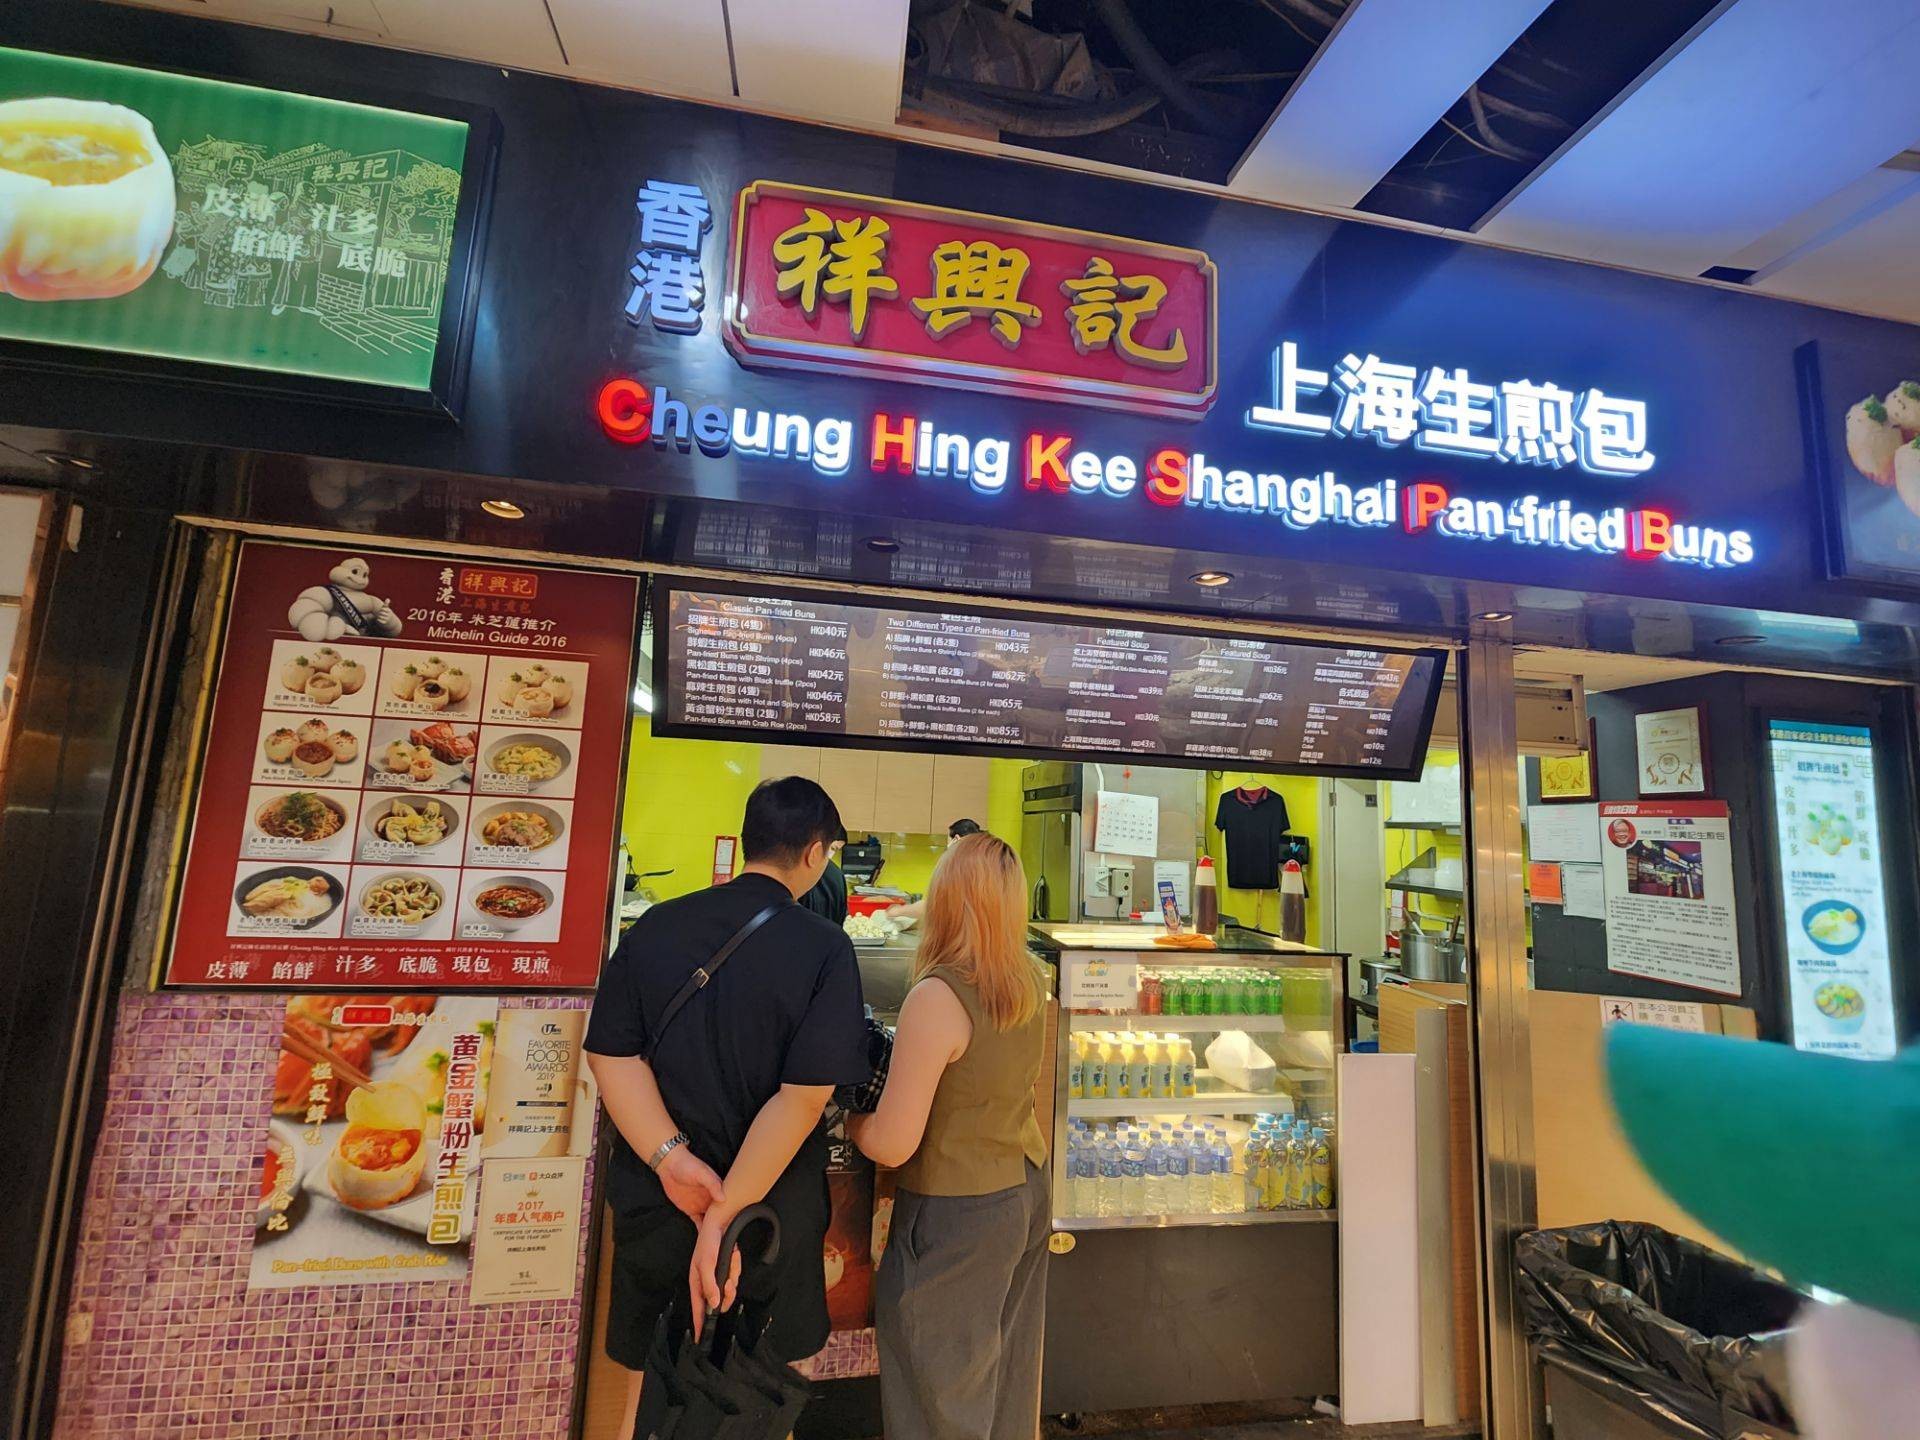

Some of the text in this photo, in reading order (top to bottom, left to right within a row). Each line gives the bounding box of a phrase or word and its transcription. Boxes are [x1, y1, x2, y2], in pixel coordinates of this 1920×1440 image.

[311, 158, 389, 182] 祥興記
[203, 184, 276, 222] 皮薄
[312, 203, 378, 235] 汁多
[338, 243, 406, 277] 底脆
[625, 179, 711, 334] 香港
[773, 208, 1188, 369] 祥興記
[1246, 341, 1655, 476] 上海生煎包
[598, 378, 1753, 568] Cheung Hing Kee Shanghai Pan-fried Buns
[436, 567, 455, 604] 香港
[465, 573, 532, 594] 祥興記
[722, 602, 815, 618] Classic Pan-fried Buns
[407, 608, 557, 632] 2016年 米芝蓮推介
[888, 618, 903, 627] Two
[905, 619, 938, 630] Different
[941, 623, 963, 633] Types
[1010, 629, 1029, 638] Buns
[428, 626, 567, 647] Michelin Guide 2016
[810, 624, 847, 637] HKD40元
[995, 641, 1028, 653] HKD43元
[1097, 637, 1149, 650] Featured Soup
[809, 646, 845, 659] HKD46元
[1220, 648, 1270, 662] Featured Soup
[719, 673, 737, 682] Buns
[807, 668, 843, 681] HKD42元
[991, 669, 1025, 681] HKD62元
[718, 695, 737, 704] Buns
[806, 689, 842, 702] HKD46元
[989, 697, 1022, 709] HKD65元
[1258, 691, 1282, 700] HKD62元
[805, 713, 841, 723] HKD58元
[987, 727, 1019, 736] HKD85元
[205, 961, 249, 979] 皮薄
[271, 962, 314, 980] 餡鮮
[336, 955, 376, 973] 汁多
[398, 956, 438, 974] 底脆
[452, 956, 491, 973] 現包
[512, 957, 550, 974] 現煎
[528, 1040, 571, 1049] FAVORITE
[526, 1050, 569, 1062] FOOD
[525, 1063, 568, 1072] AWARDS
[517, 1201, 544, 1211] 2017
[272, 1253, 448, 1273] Pan-fried Buns with Crab Roe
